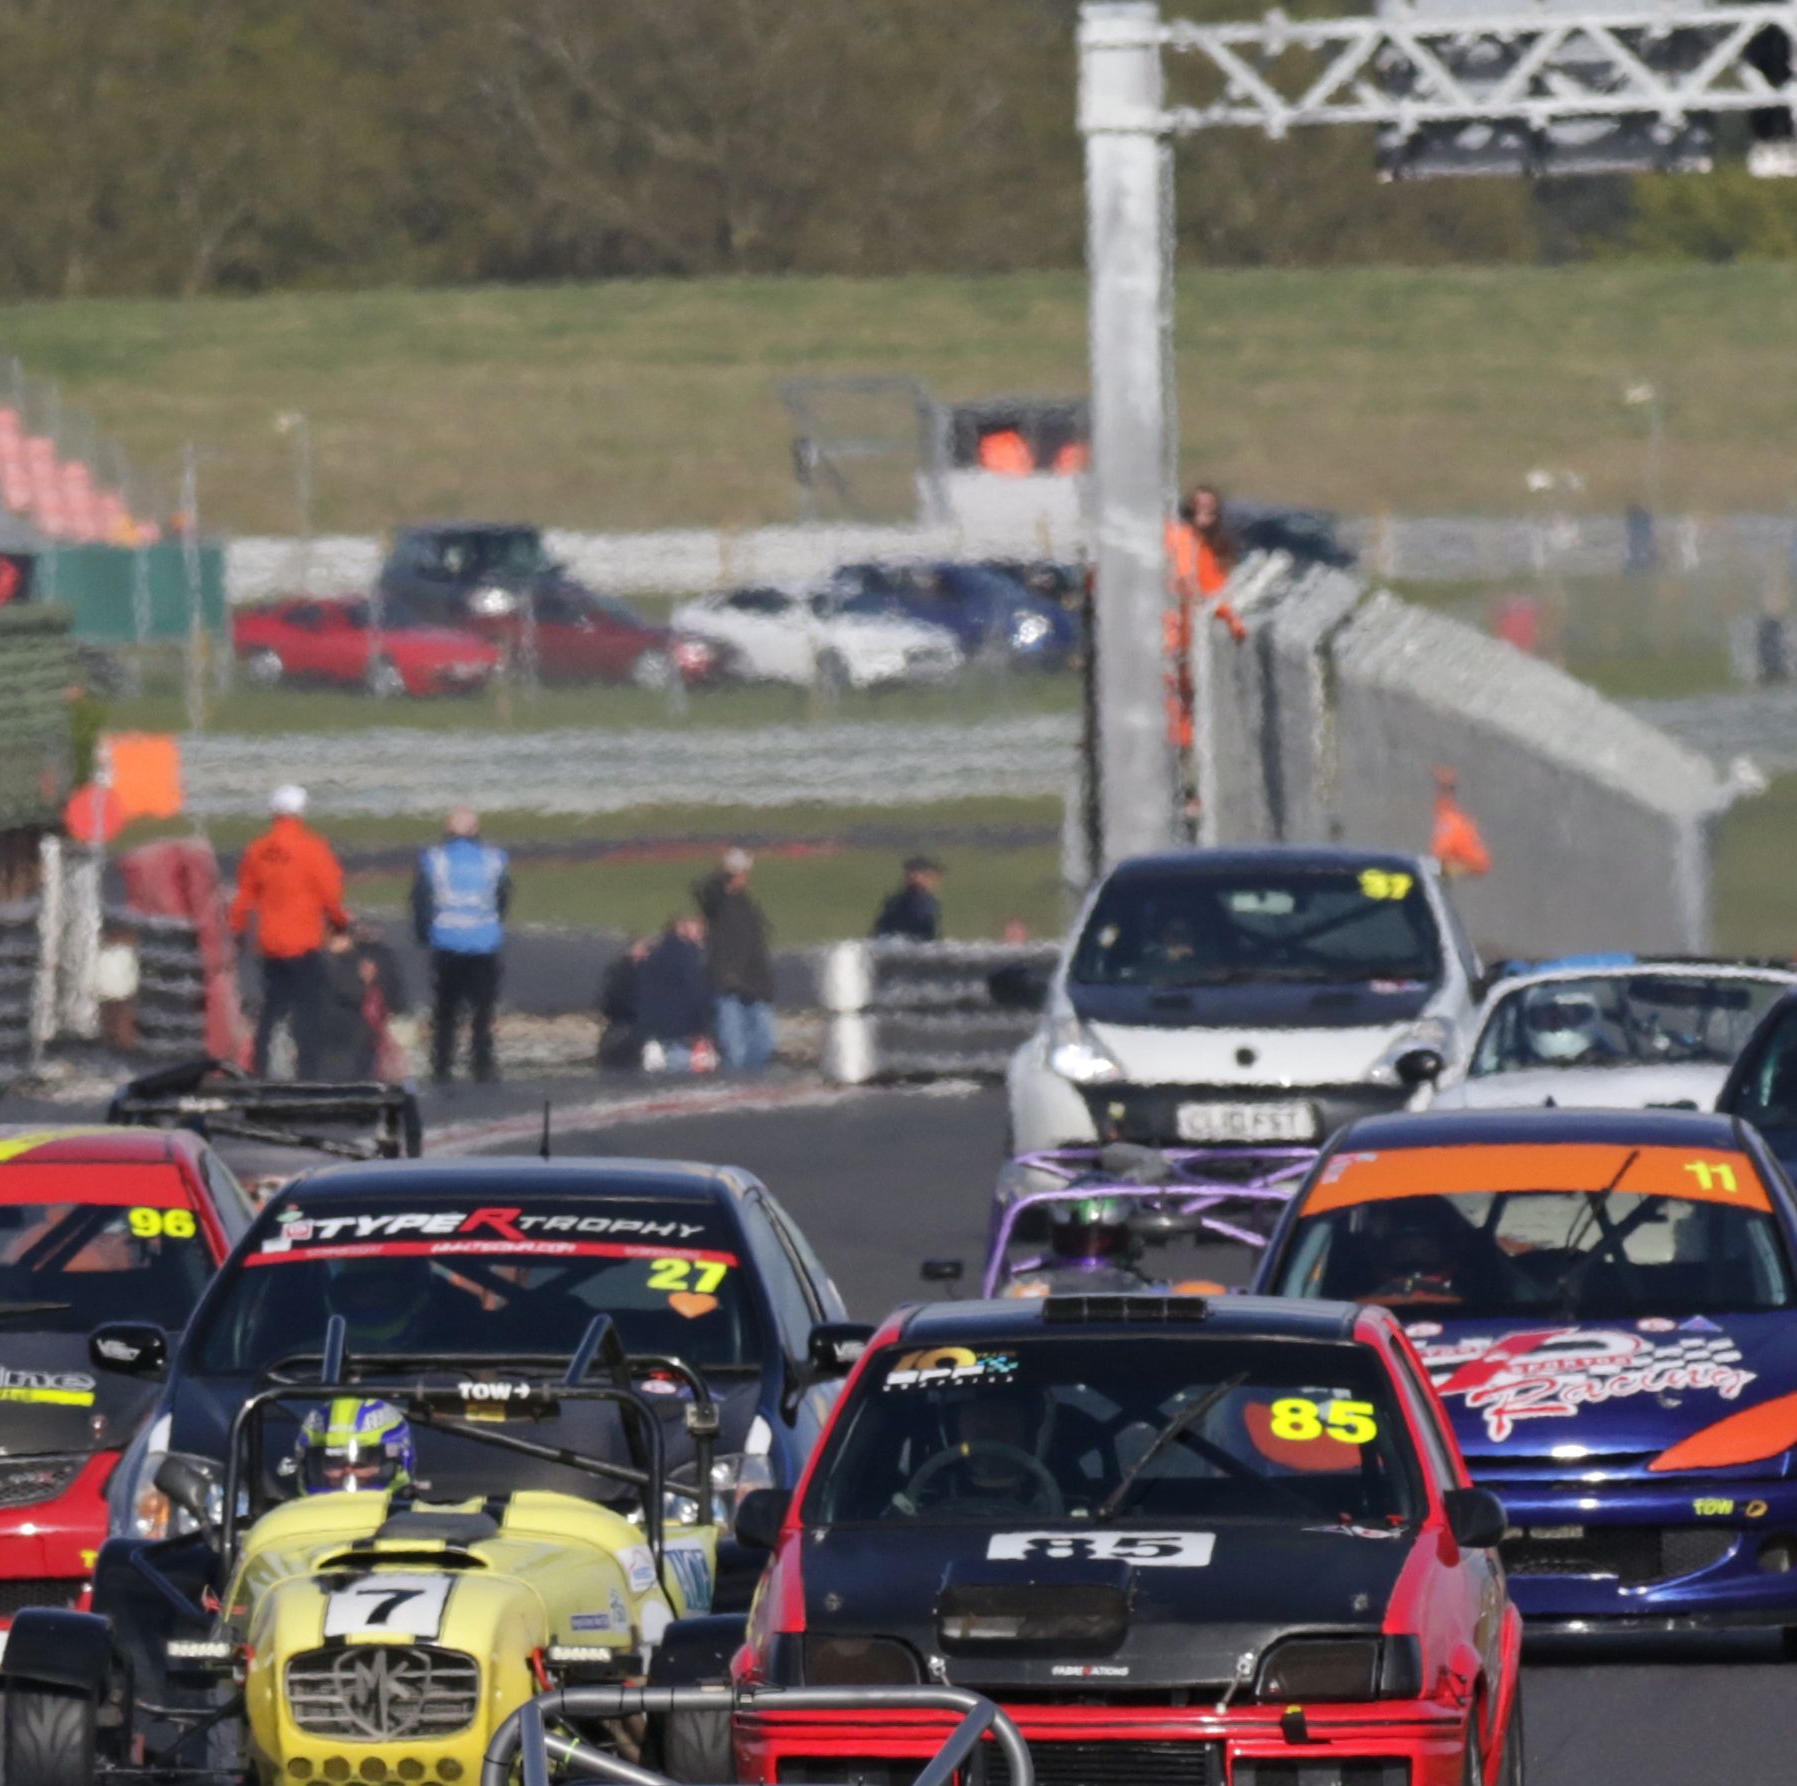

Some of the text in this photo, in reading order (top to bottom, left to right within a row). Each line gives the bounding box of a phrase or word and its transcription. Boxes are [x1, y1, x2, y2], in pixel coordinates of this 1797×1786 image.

[1684, 1160, 1738, 1194] 11
[129, 1206, 196, 1239] 96
[520, 1215, 705, 1239] TROPHY
[646, 1257, 728, 1293] 27
[457, 1382, 512, 1400] TOW
[1466, 1361, 1757, 1441] Racing
[1270, 1397, 1378, 1445] 85
[1693, 1499, 1735, 1515] TOW
[1021, 1535, 1186, 1560] 85
[355, 1589, 426, 1626] 7
